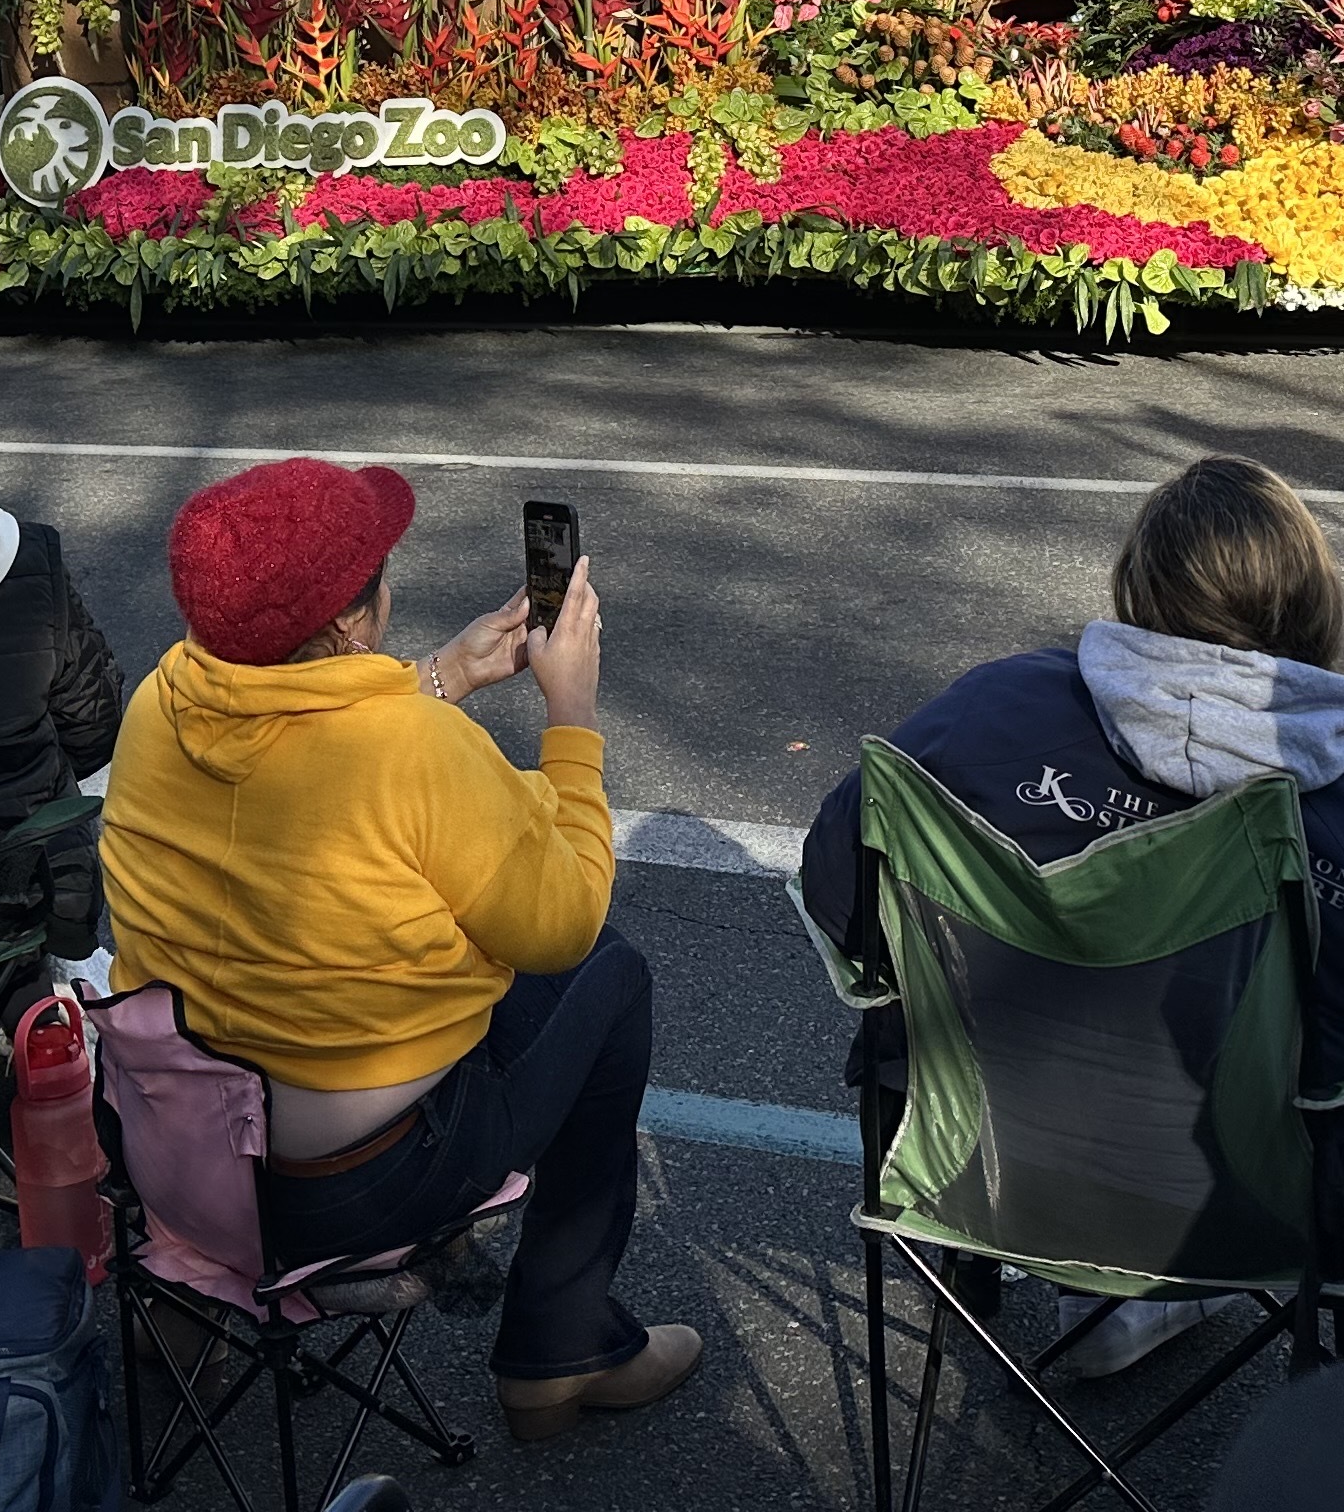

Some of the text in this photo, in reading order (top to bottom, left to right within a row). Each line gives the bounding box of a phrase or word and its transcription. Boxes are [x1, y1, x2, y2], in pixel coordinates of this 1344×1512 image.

[112, 106, 497, 172] San Diego Zoo
[1106, 786, 1159, 817] THE
